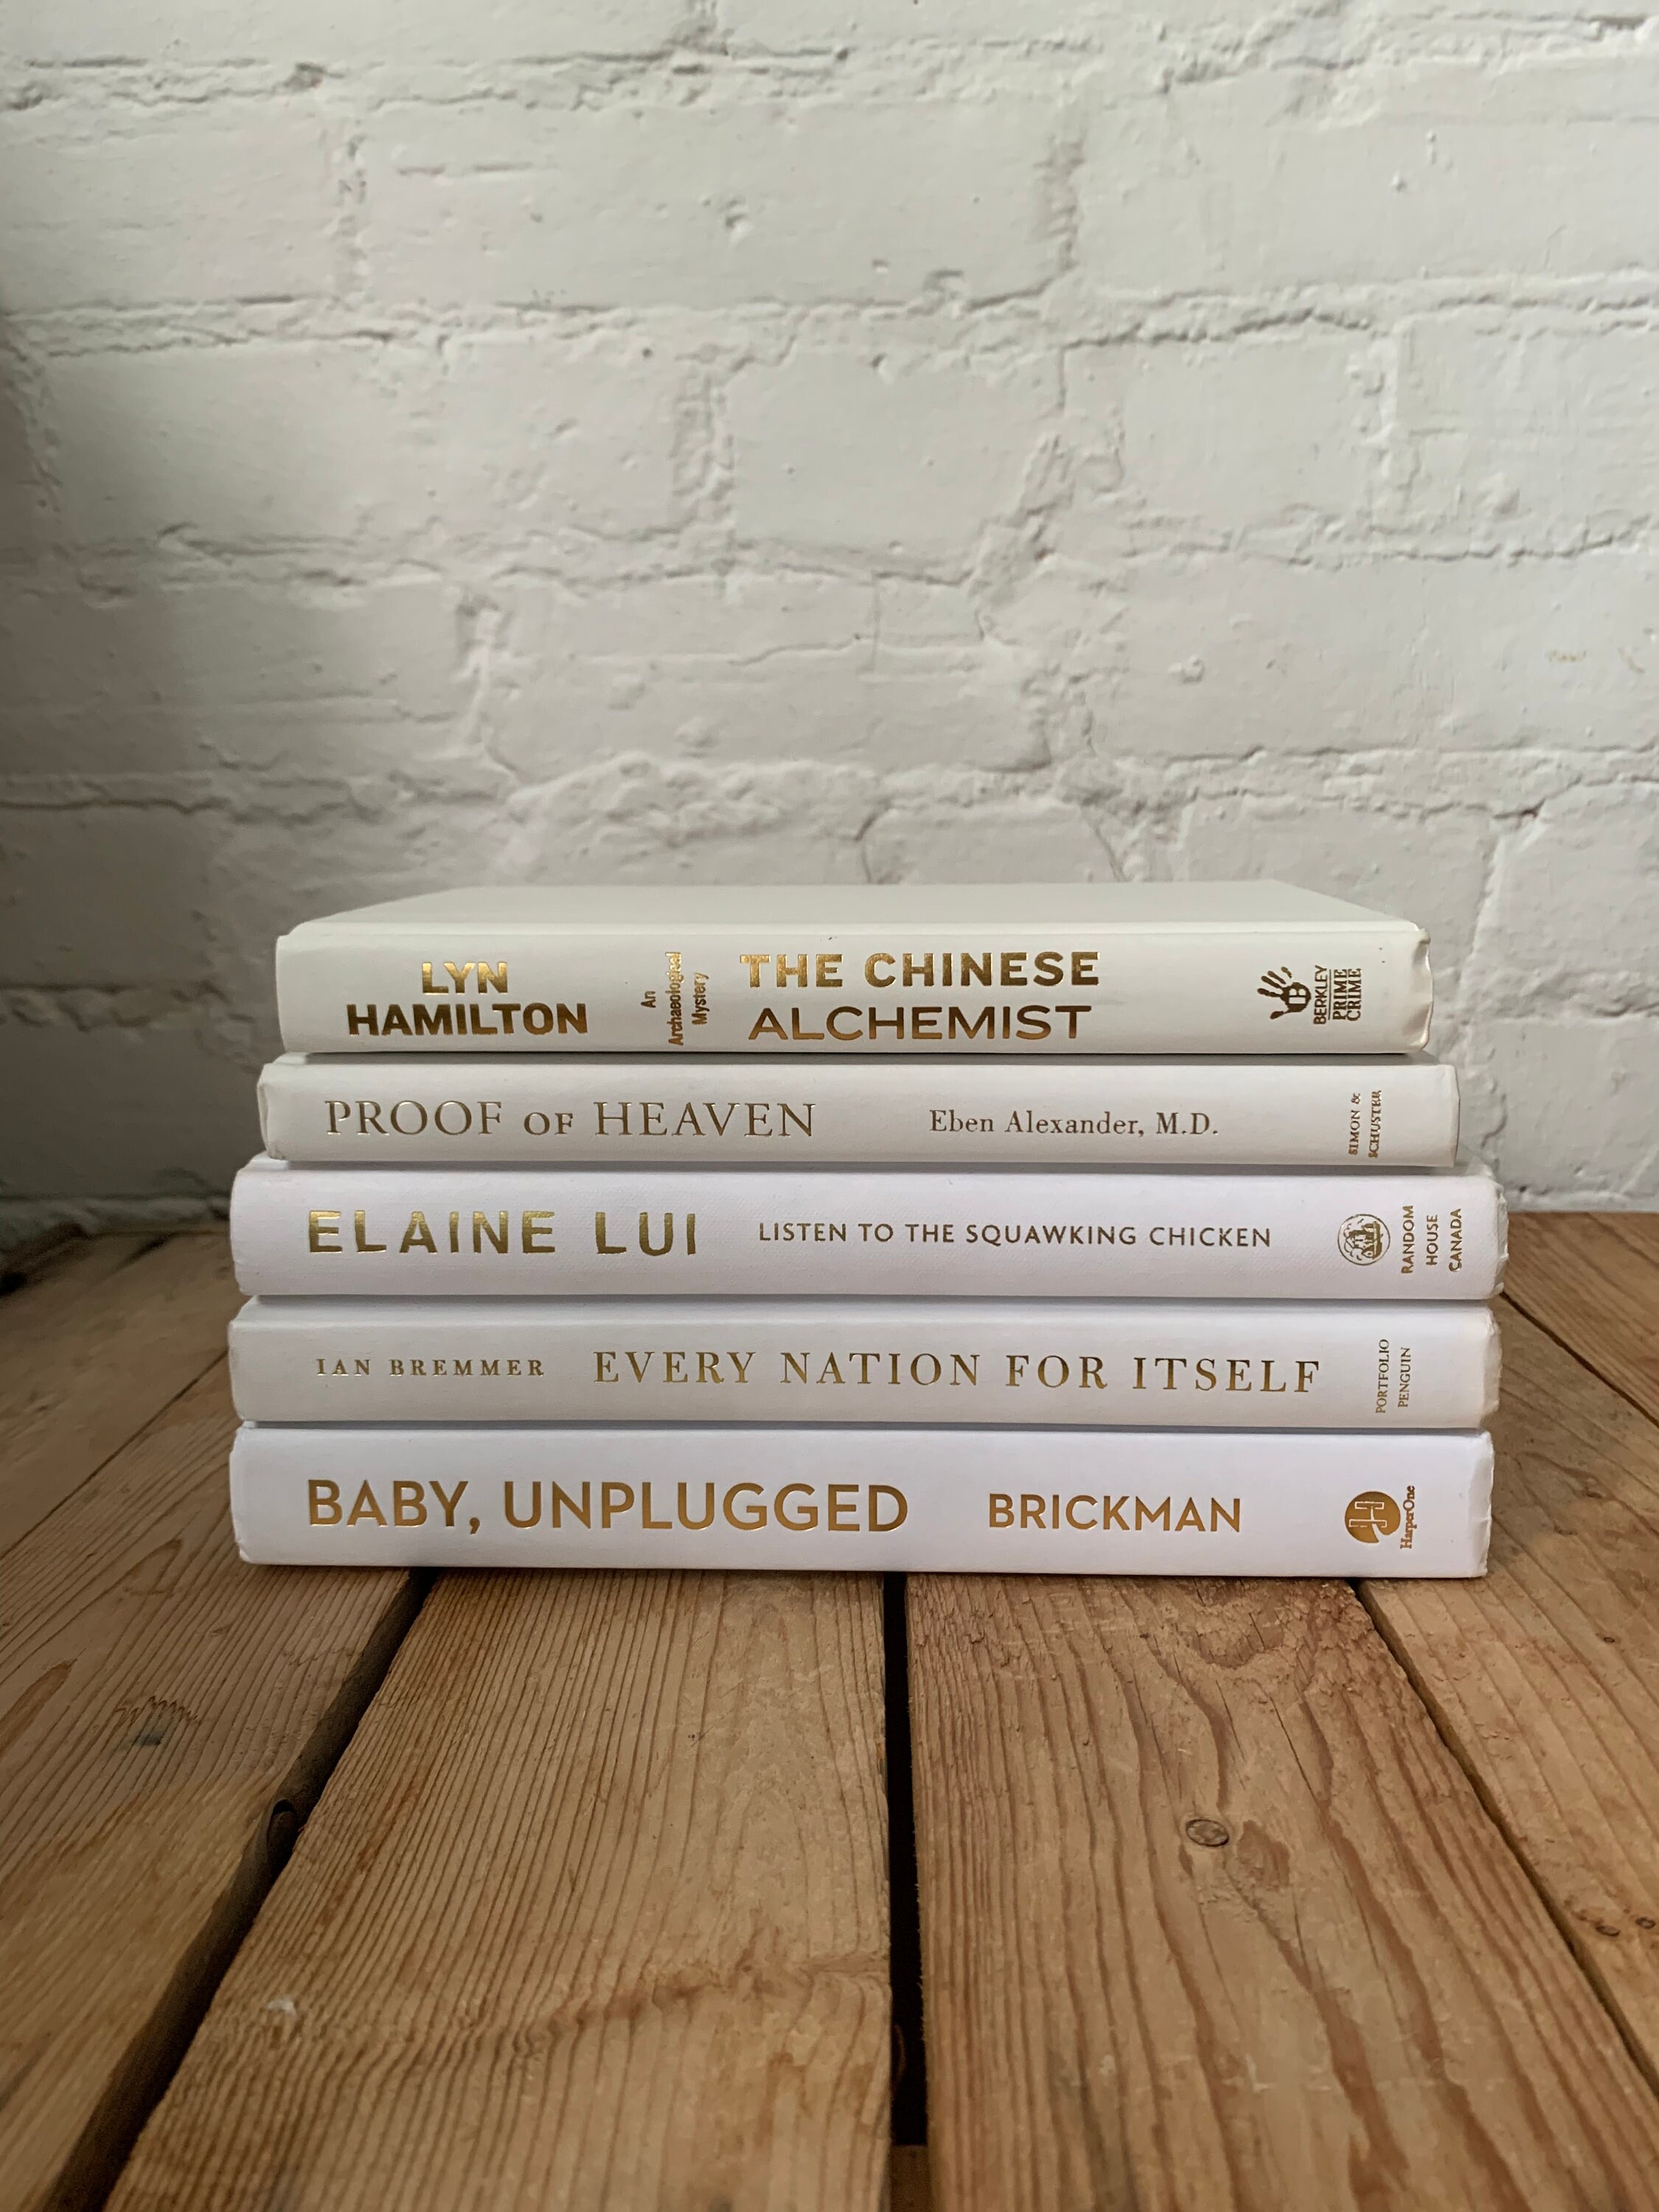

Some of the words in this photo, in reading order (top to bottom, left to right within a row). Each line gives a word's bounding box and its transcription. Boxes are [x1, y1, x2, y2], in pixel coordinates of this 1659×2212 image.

[421, 961, 509, 995] LYN
[740, 953, 844, 988] THE
[864, 950, 1100, 988] CHINESE
[641, 991, 656, 1008] An
[665, 951, 685, 1046] Archaeological
[692, 973, 710, 1025] Mystery
[1313, 965, 1327, 1024] BERKLEY
[1332, 968, 1348, 1021] PRIME
[1346, 967, 1363, 1022] CRIME
[347, 1002, 588, 1036] HAMILTON
[748, 1004, 1092, 1040] ALCHEMIST
[324, 1099, 503, 1136] PROOF
[593, 1102, 817, 1138] HEAVEN
[1351, 1092, 1362, 1105] &
[929, 1109, 995, 1133] Eben
[1005, 1110, 1145, 1138] Alexander,
[1155, 1112, 1220, 1135] M.D.
[1347, 1110, 1362, 1156] SIMON
[1368, 1090, 1382, 1159] SCHUSTER
[308, 1210, 556, 1254] ELAINE
[594, 1211, 697, 1257] LUI
[759, 1222, 846, 1242] LISTEN
[858, 1223, 894, 1243] TO
[905, 1224, 955, 1243] THE
[966, 1224, 1136, 1248] SQUAWKING
[1150, 1226, 1271, 1248] CHICKEN
[1401, 1205, 1416, 1274] RANDOM
[1425, 1214, 1439, 1266] HOUSE
[1448, 1208, 1463, 1273] CANADA
[316, 1358, 371, 1377] IAN
[389, 1359, 545, 1377] BREMMER
[593, 1351, 757, 1384] EVERY
[779, 1352, 981, 1387] NATION
[1005, 1354, 1108, 1391] FOR
[1132, 1357, 1320, 1394] ITSELF
[1375, 1338, 1390, 1414] PORTFOLIO
[1397, 1346, 1411, 1408] PENGUIN
[308, 1479, 481, 1535] BABY,
[504, 1481, 908, 1533] UNPLUGGED
[988, 1492, 1242, 1533] BRICKMAN
[1399, 1485, 1417, 1549] HarperOne
